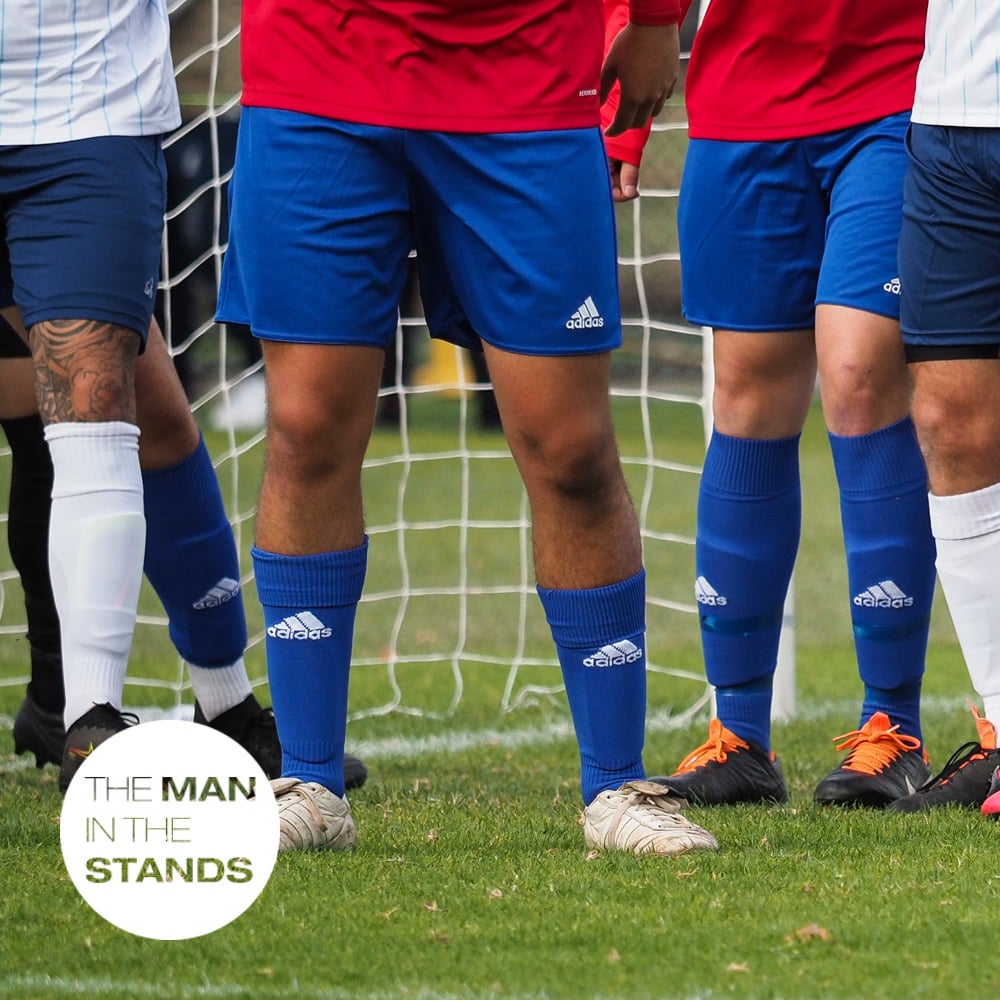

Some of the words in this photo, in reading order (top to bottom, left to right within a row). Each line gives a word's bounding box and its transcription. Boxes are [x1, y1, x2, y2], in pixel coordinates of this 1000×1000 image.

[565, 316, 604, 329] adidas
[853, 595, 914, 608] adidas
[267, 626, 333, 640] adidas
[582, 648, 643, 668] adidas
